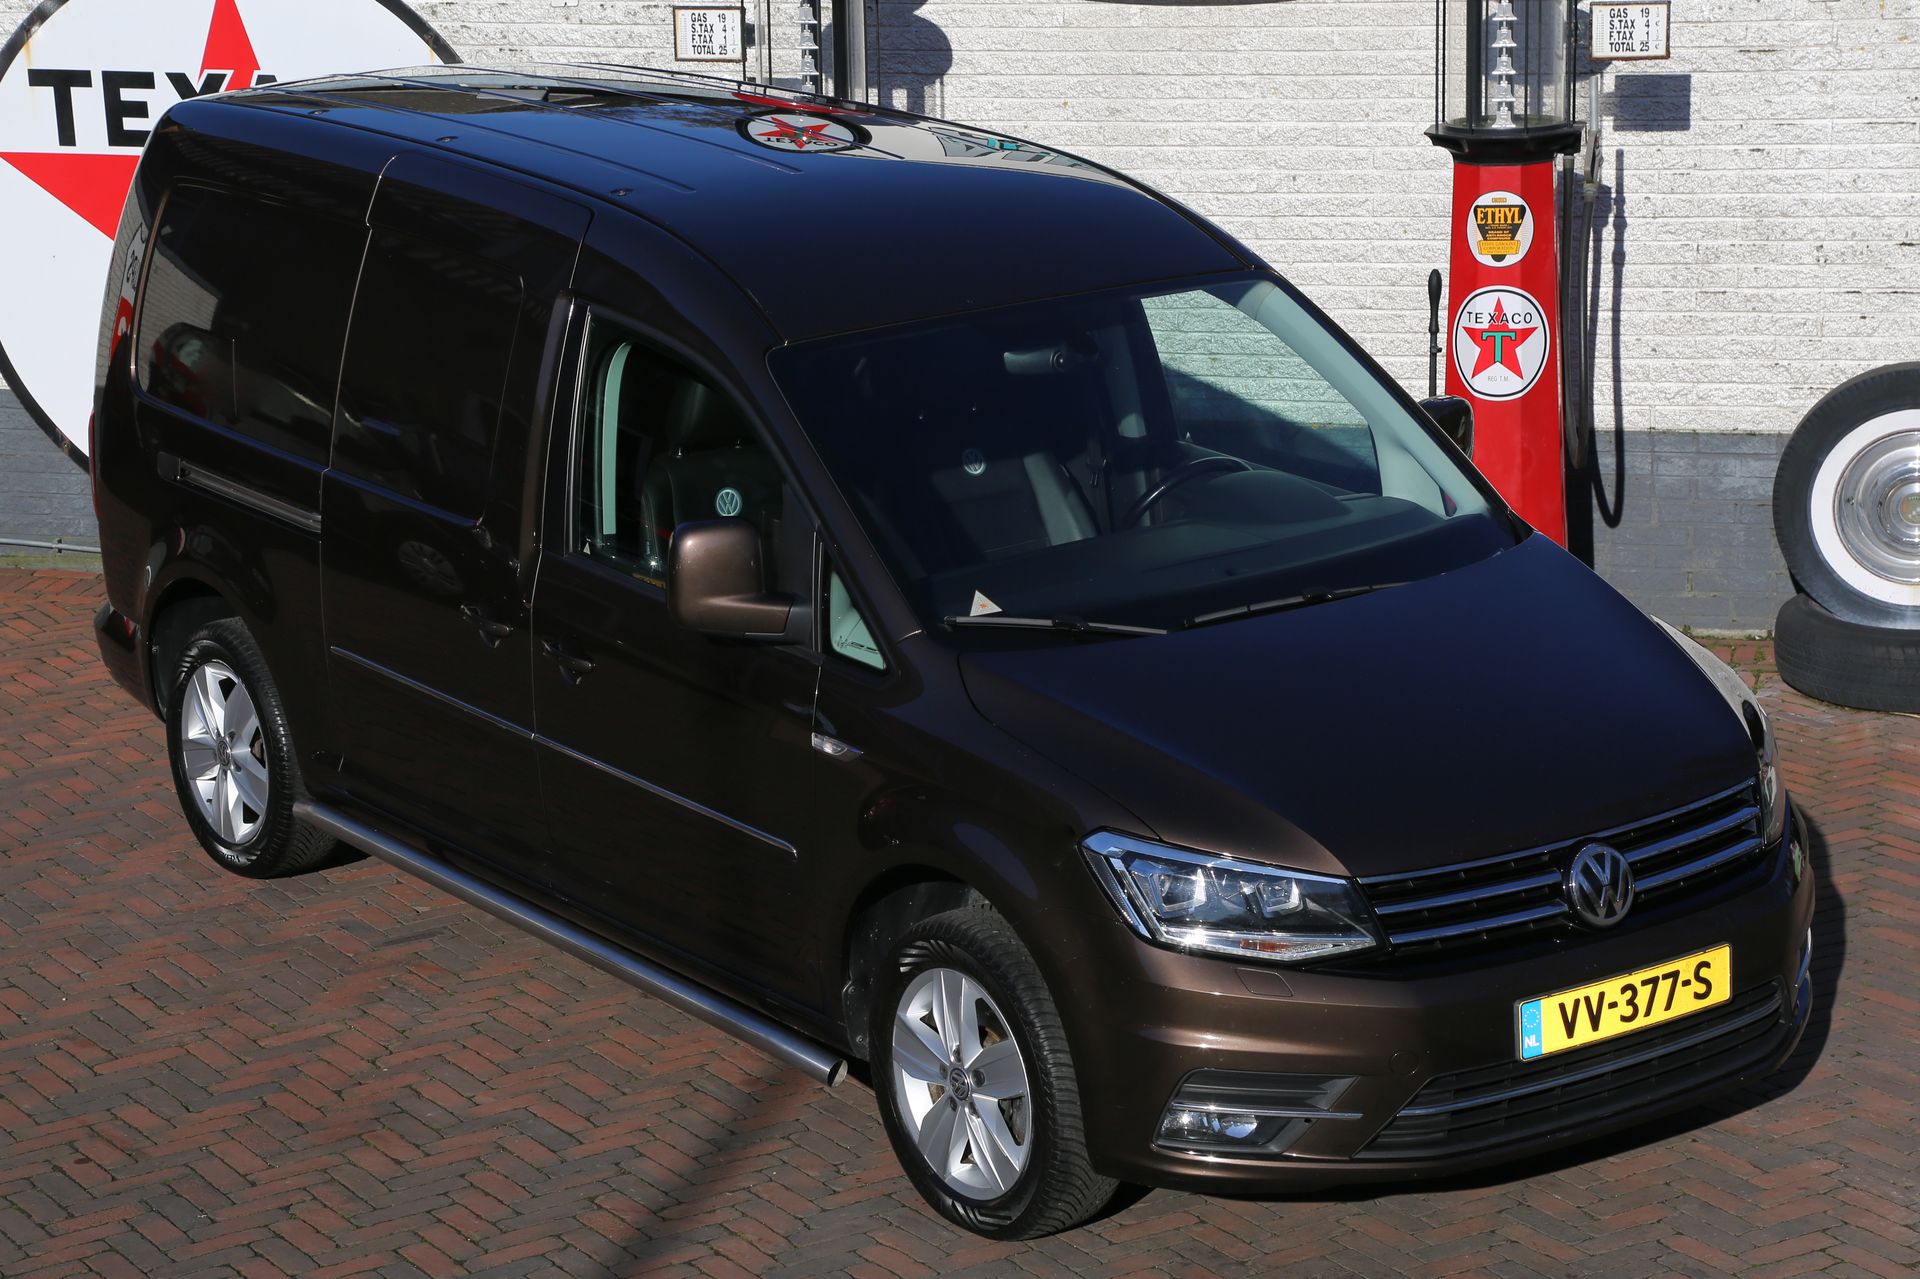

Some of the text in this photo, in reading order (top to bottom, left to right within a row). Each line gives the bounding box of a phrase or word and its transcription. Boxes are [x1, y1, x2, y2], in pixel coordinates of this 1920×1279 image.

[691, 12, 726, 23] GAS 19
[1609, 7, 1650, 19] GAS 19
[691, 24, 727, 34] S.TAX 4
[1609, 19, 1650, 30] S.TAX 4
[692, 34, 713, 44] F.TAX
[1609, 30, 1634, 41] F.TAX
[692, 45, 728, 55] TOTAL 25
[1609, 41, 1650, 52] TOTAL 25
[1476, 207, 1523, 224] ETHYL
[1466, 311, 1533, 325] TEXACO
[1481, 331, 1517, 363] T
[1558, 960, 1713, 1040] VV-377-S
[1524, 1033, 1540, 1049] NL
